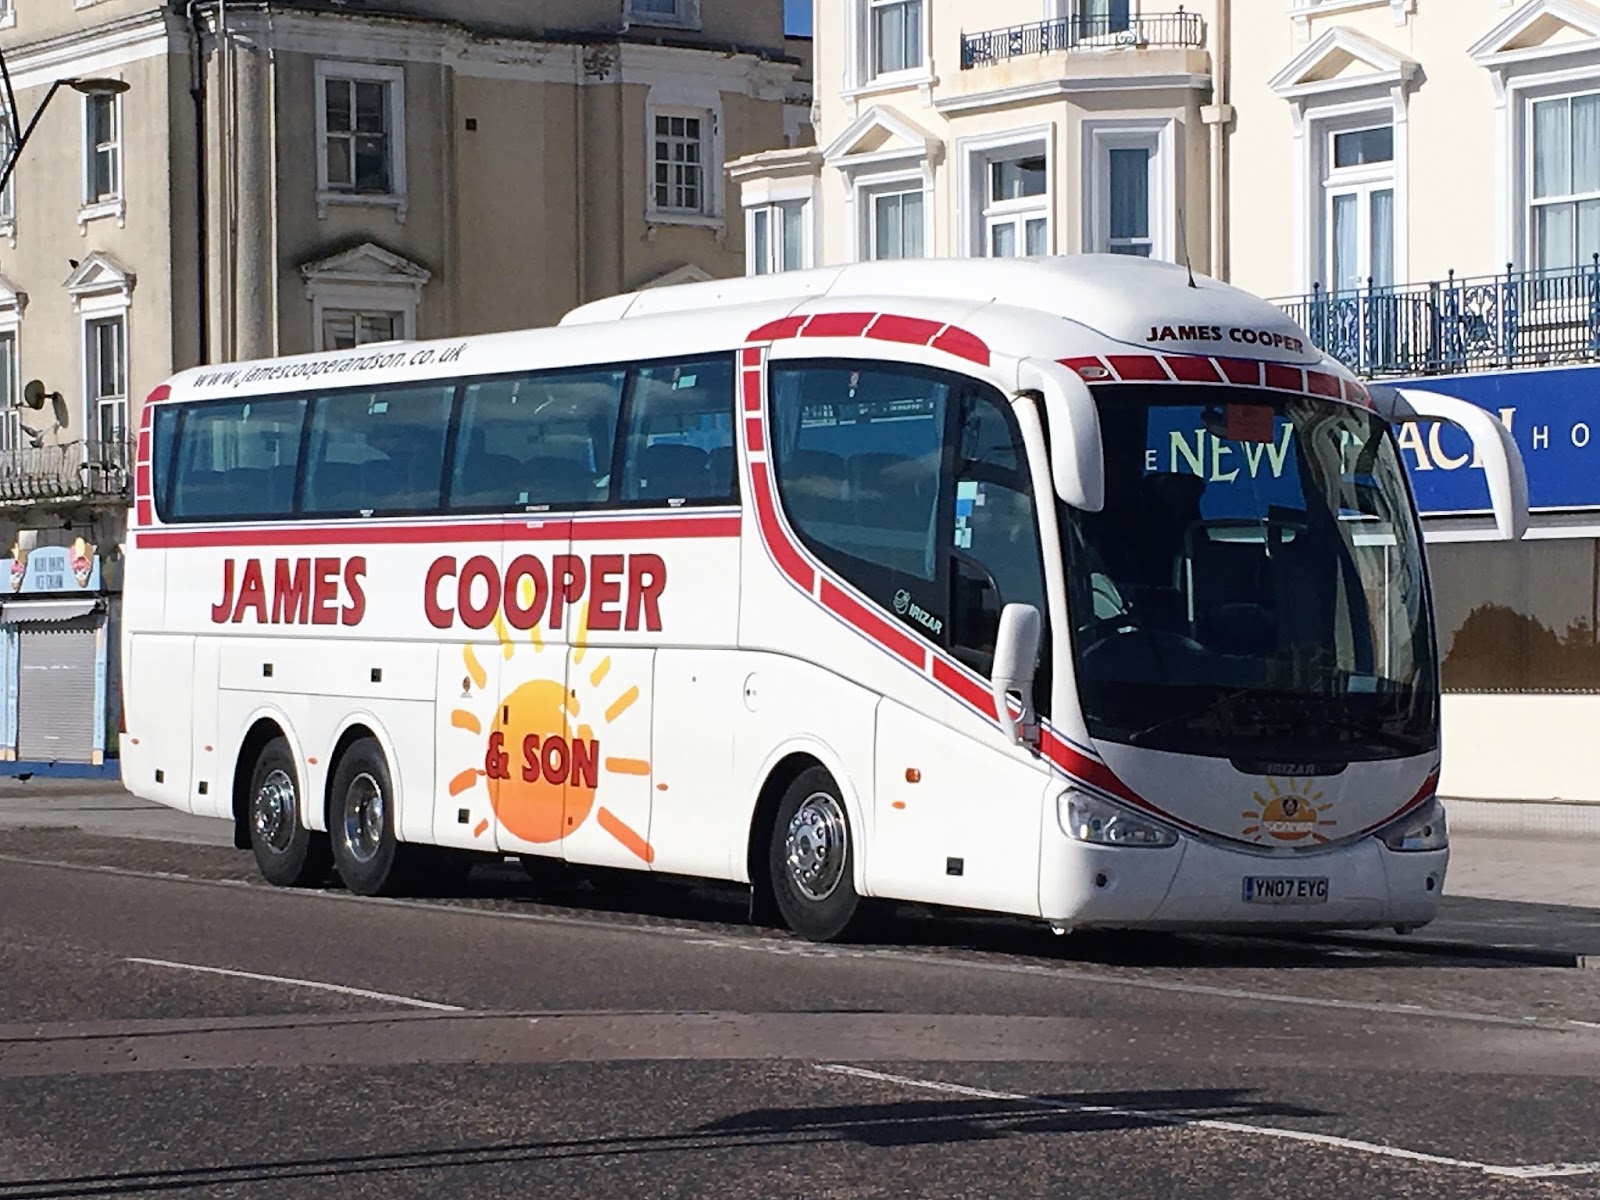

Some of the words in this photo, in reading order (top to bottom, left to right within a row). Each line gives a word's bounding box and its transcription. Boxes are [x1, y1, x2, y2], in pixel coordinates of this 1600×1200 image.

[1146, 325, 1223, 342] JAMES
[1228, 327, 1304, 353] COOPER
[193, 343, 468, 388] www.jamescooperandson.co.uk
[1168, 422, 1295, 485] NEW
[211, 556, 367, 626] JAMES
[424, 553, 667, 632] COOPER
[908, 603, 943, 635] IRIZAR
[485, 731, 511, 780] &
[522, 733, 600, 788] SON
[1255, 880, 1296, 898] YN07
[1298, 880, 1326, 898] EYG
